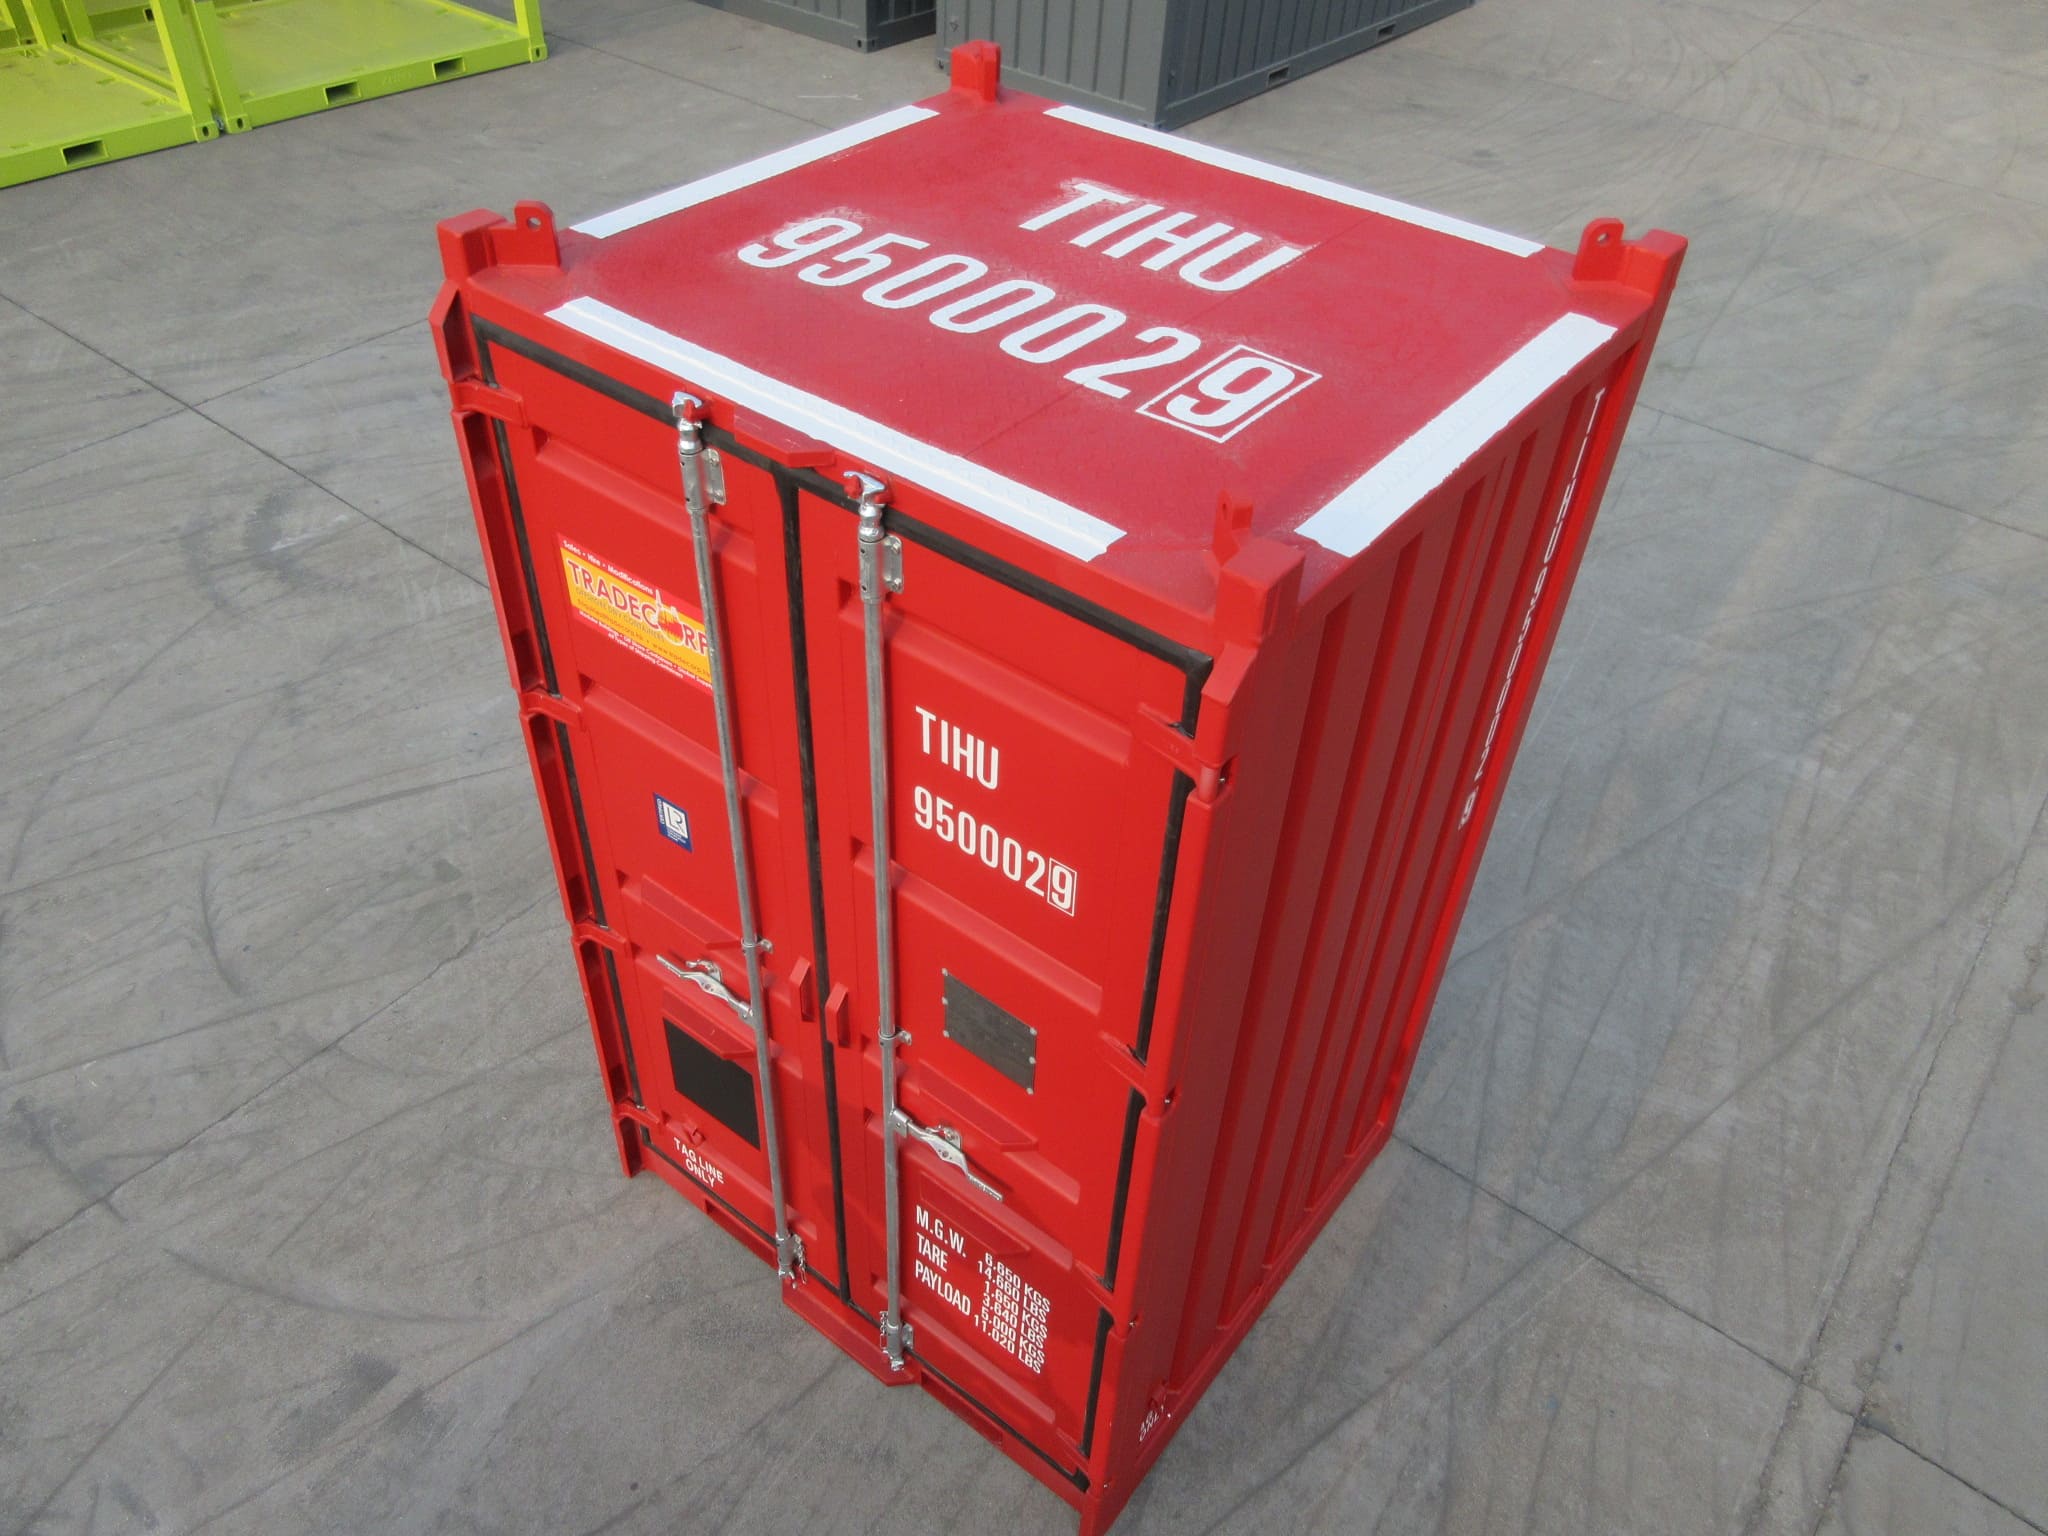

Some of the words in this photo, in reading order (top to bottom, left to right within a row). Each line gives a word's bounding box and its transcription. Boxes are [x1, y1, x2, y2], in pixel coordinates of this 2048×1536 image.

[1018, 181, 1306, 292] TIHU
[915, 705, 999, 790] TIHU
[673, 1136, 696, 1164] TAG
[699, 1156, 724, 1184] LINE
[685, 1158, 714, 1188] ONLY
[916, 1204, 967, 1258] M.G.W.
[916, 1232, 948, 1272] TARE
[915, 1260, 971, 1317] PAYLOAD
[1024, 1282, 1050, 1313] KGS
[1022, 1310, 1048, 1339] KGS
[1023, 1295, 1047, 1324] LBS
[974, 1314, 1015, 1354] 11.020
[1018, 1349, 1041, 1374] LBS
[1019, 1336, 1045, 1364] KGS
[1020, 1322, 1044, 1350] LBS
